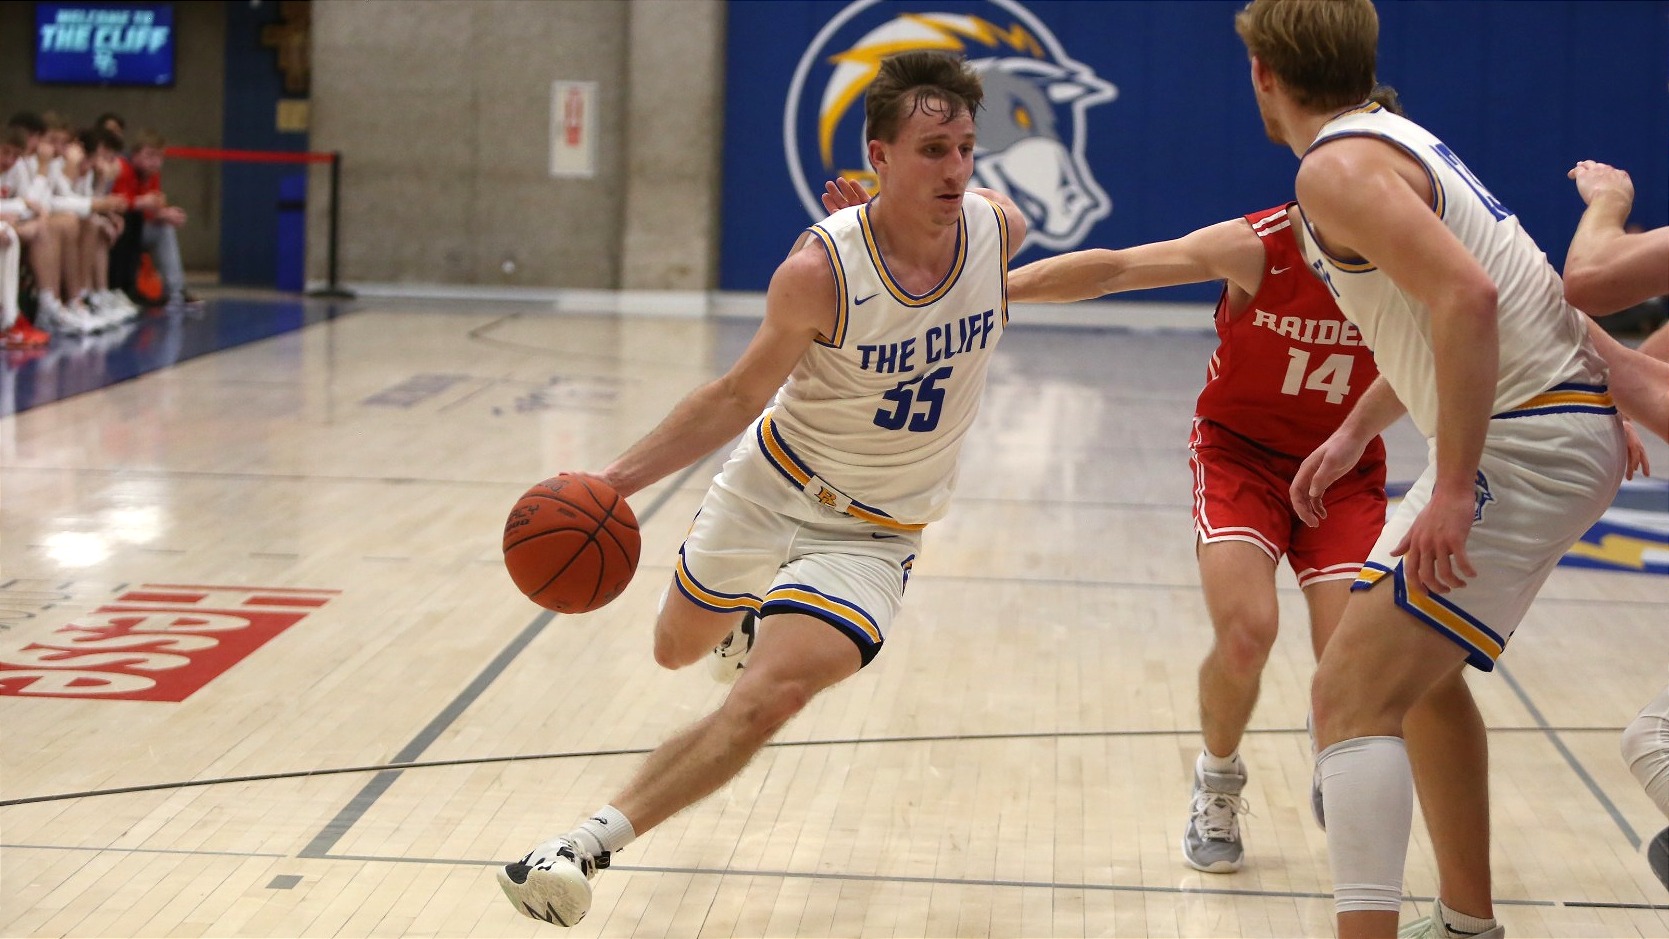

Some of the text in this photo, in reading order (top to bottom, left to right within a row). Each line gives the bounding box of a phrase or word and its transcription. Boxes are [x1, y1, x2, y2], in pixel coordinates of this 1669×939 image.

[40, 22, 171, 54] THE CLIFF
[132, 9, 156, 25] TO
[856, 308, 994, 374] THE CLIFF
[1252, 308, 1369, 347] RAIDE
[872, 365, 954, 433] 55
[1280, 346, 1356, 405] 14
